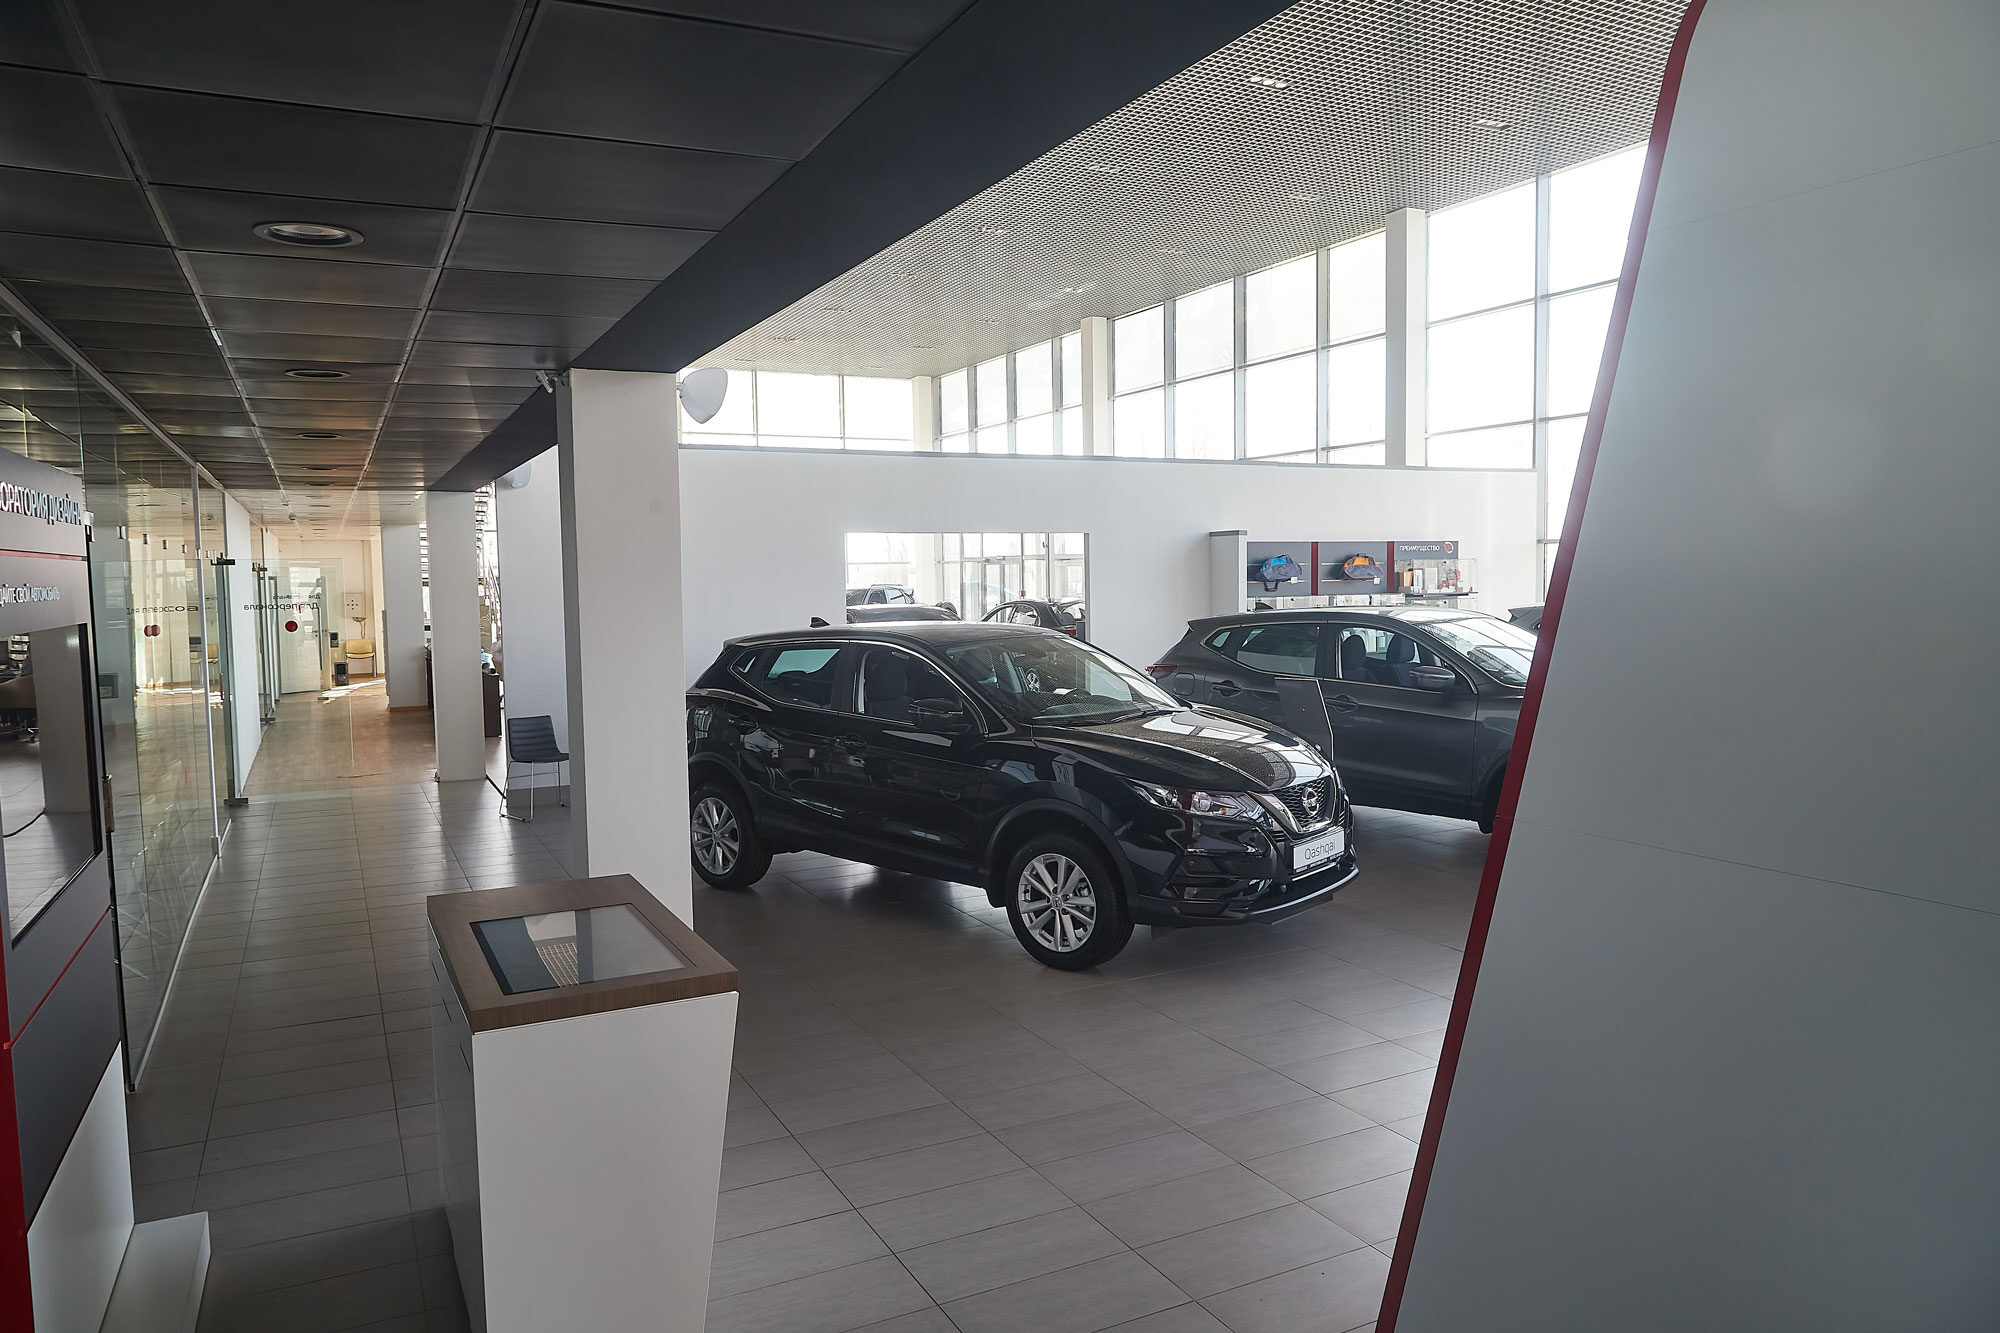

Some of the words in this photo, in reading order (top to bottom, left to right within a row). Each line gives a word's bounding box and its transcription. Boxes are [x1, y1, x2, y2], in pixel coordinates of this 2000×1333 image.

[0, 480, 48, 520] ОРАТОРИЯ
[48, 493, 82, 526] ДИЗАЙНА
[16, 583, 31, 604] СВОЙ
[1304, 838, 1336, 861] Qashqai
